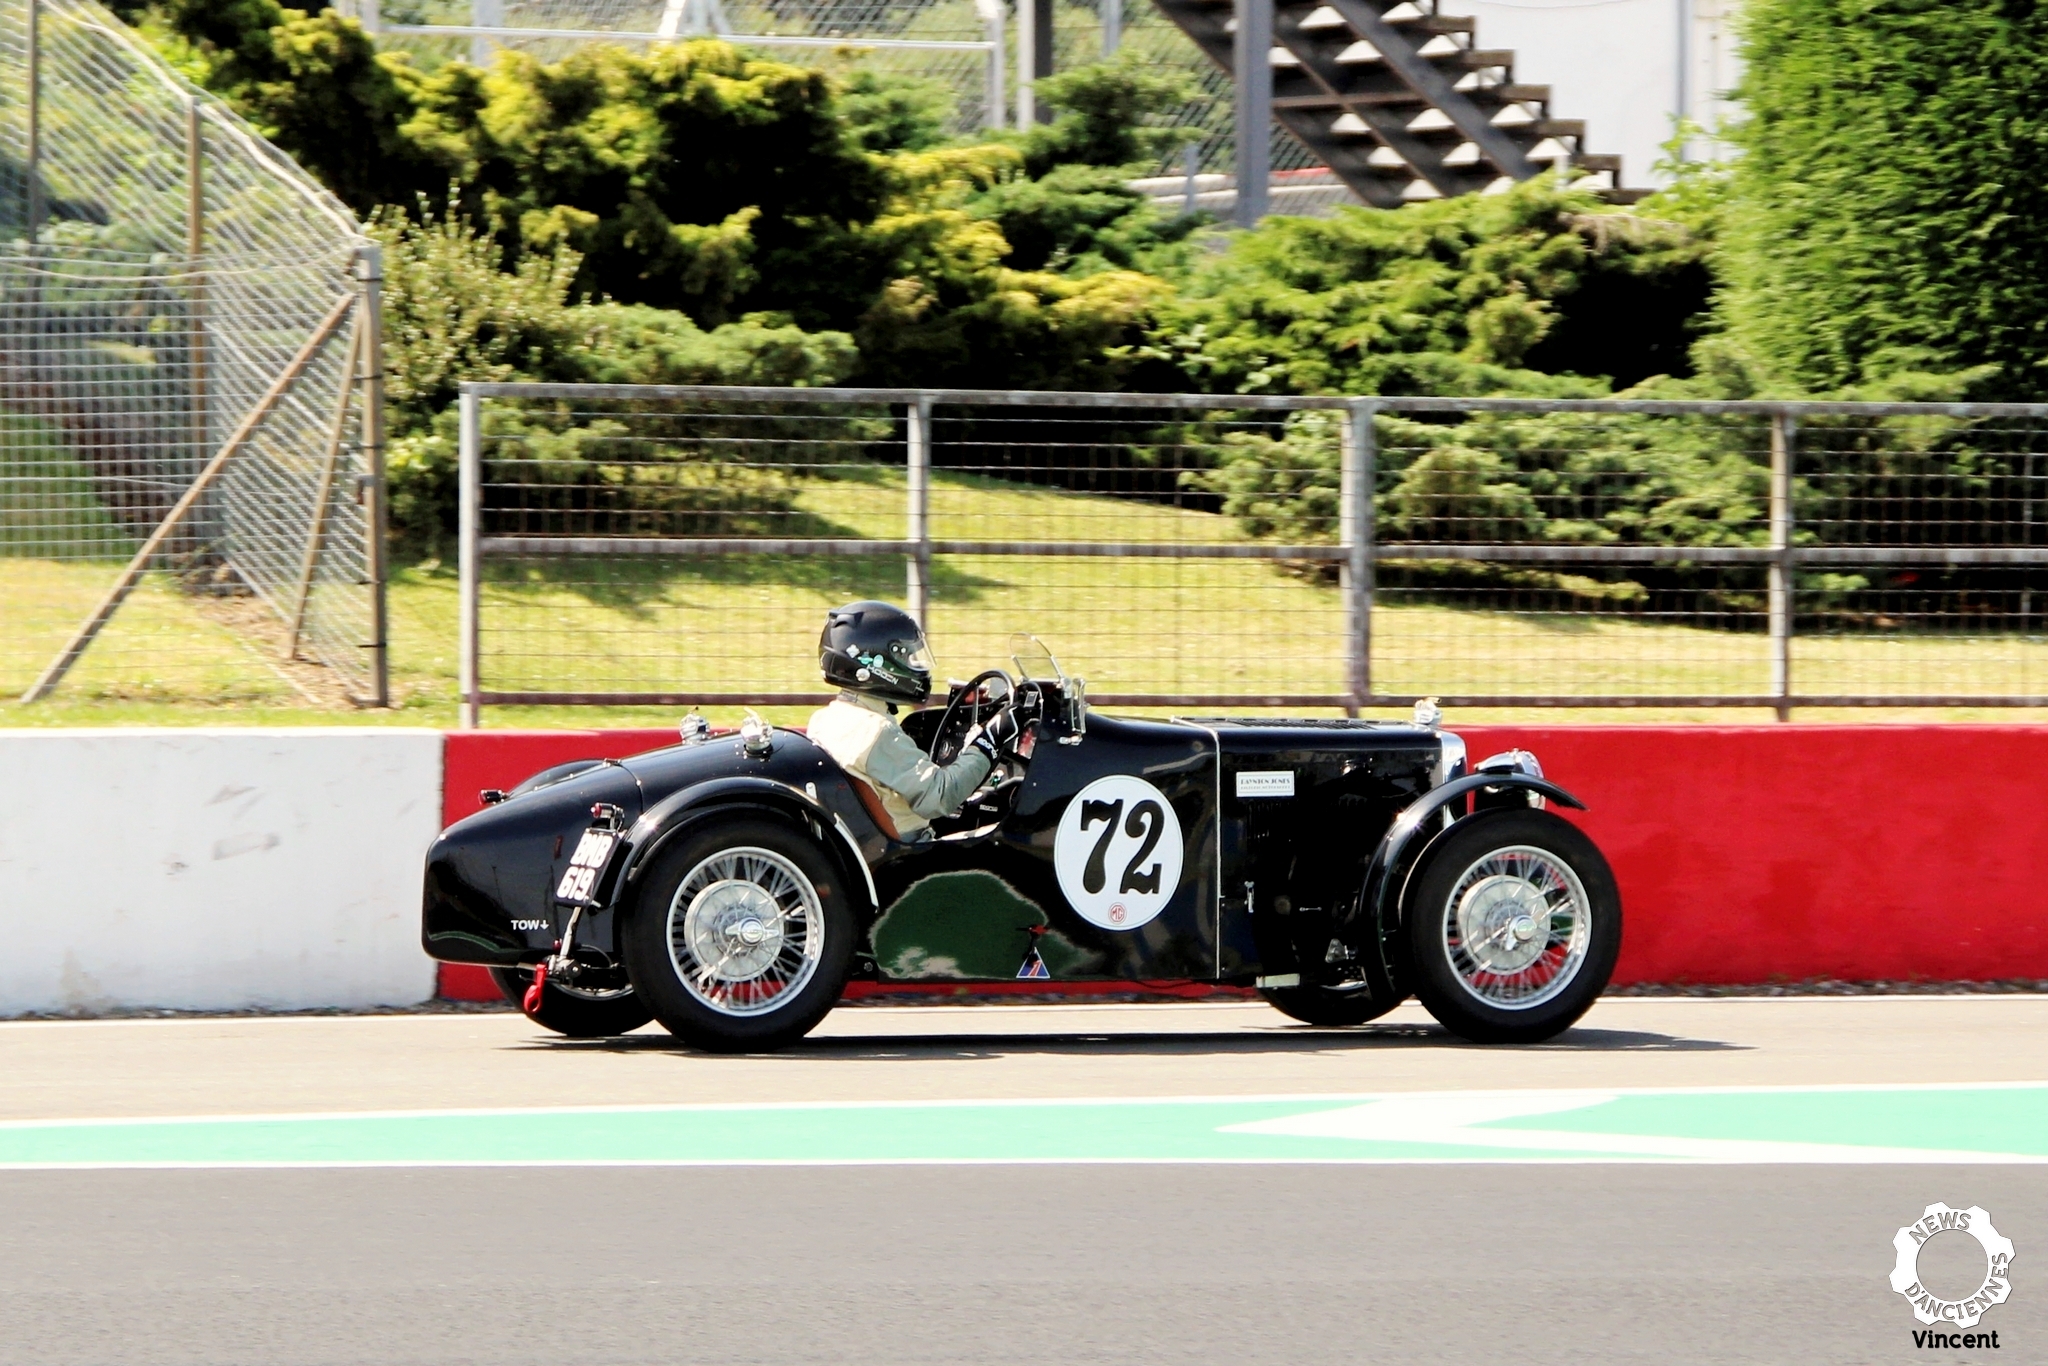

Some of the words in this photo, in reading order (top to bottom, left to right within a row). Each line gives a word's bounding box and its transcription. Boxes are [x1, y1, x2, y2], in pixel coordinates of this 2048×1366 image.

[1080, 798, 1165, 895] 72
[556, 866, 596, 901] 619
[510, 919, 540, 931] TOW
